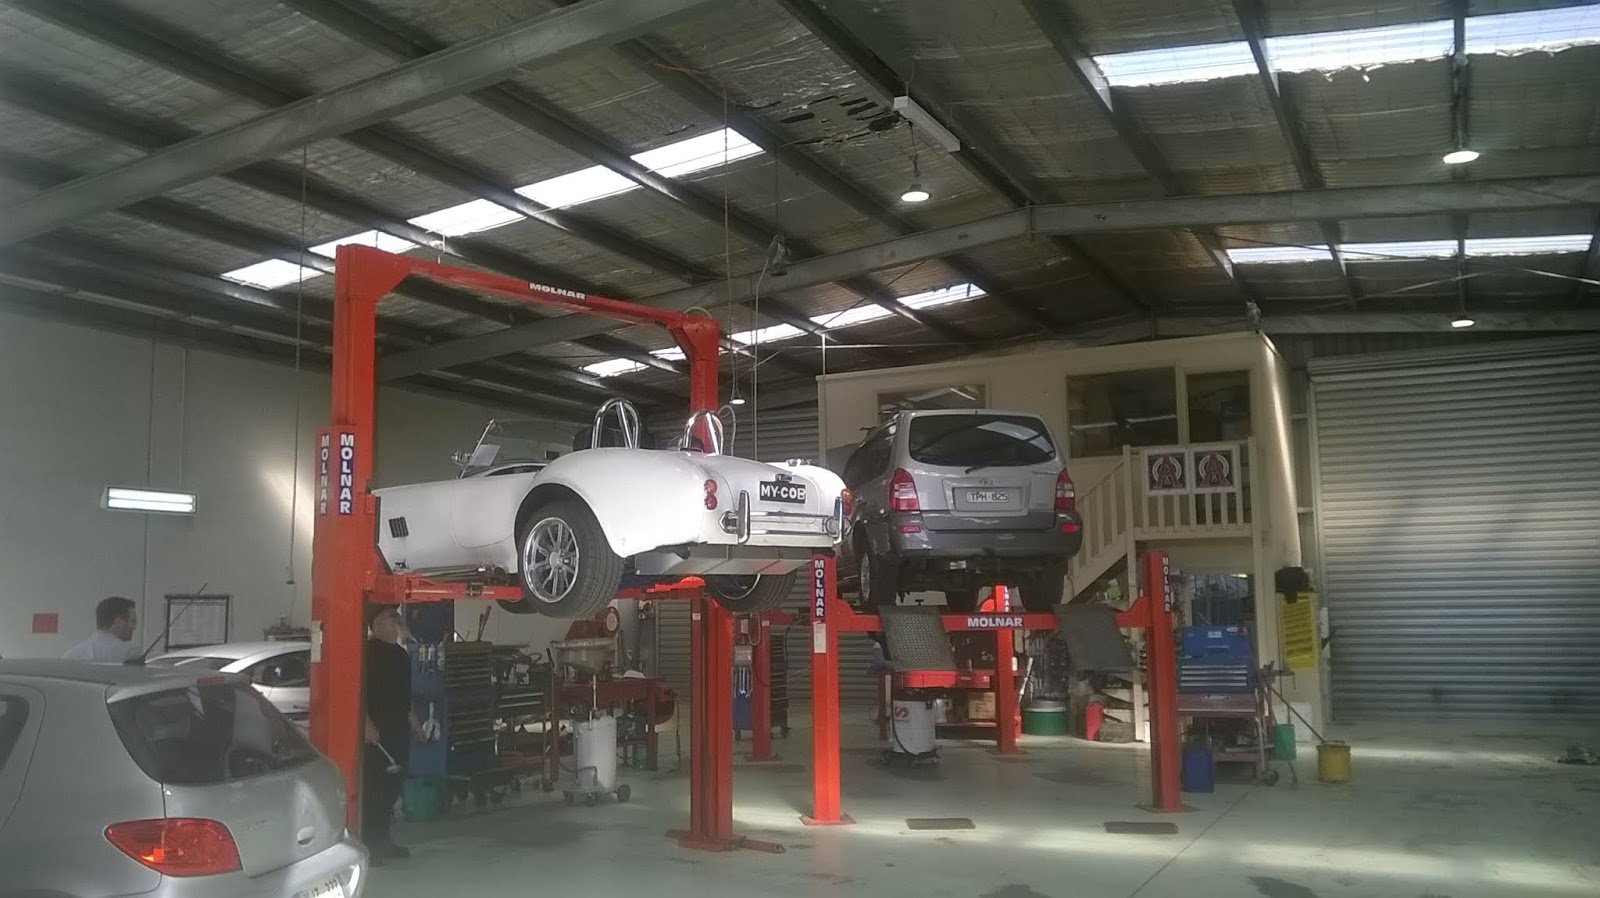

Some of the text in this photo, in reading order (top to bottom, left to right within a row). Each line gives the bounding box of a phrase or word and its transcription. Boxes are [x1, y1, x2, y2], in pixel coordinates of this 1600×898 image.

[529, 283, 586, 300] MOLNAR
[320, 434, 330, 514] MOLNAR
[340, 433, 355, 514] MOLNAR
[814, 559, 825, 617] MOLNAR
[1162, 556, 1171, 613] MOLNAR
[967, 617, 1023, 627] MOLNAR
